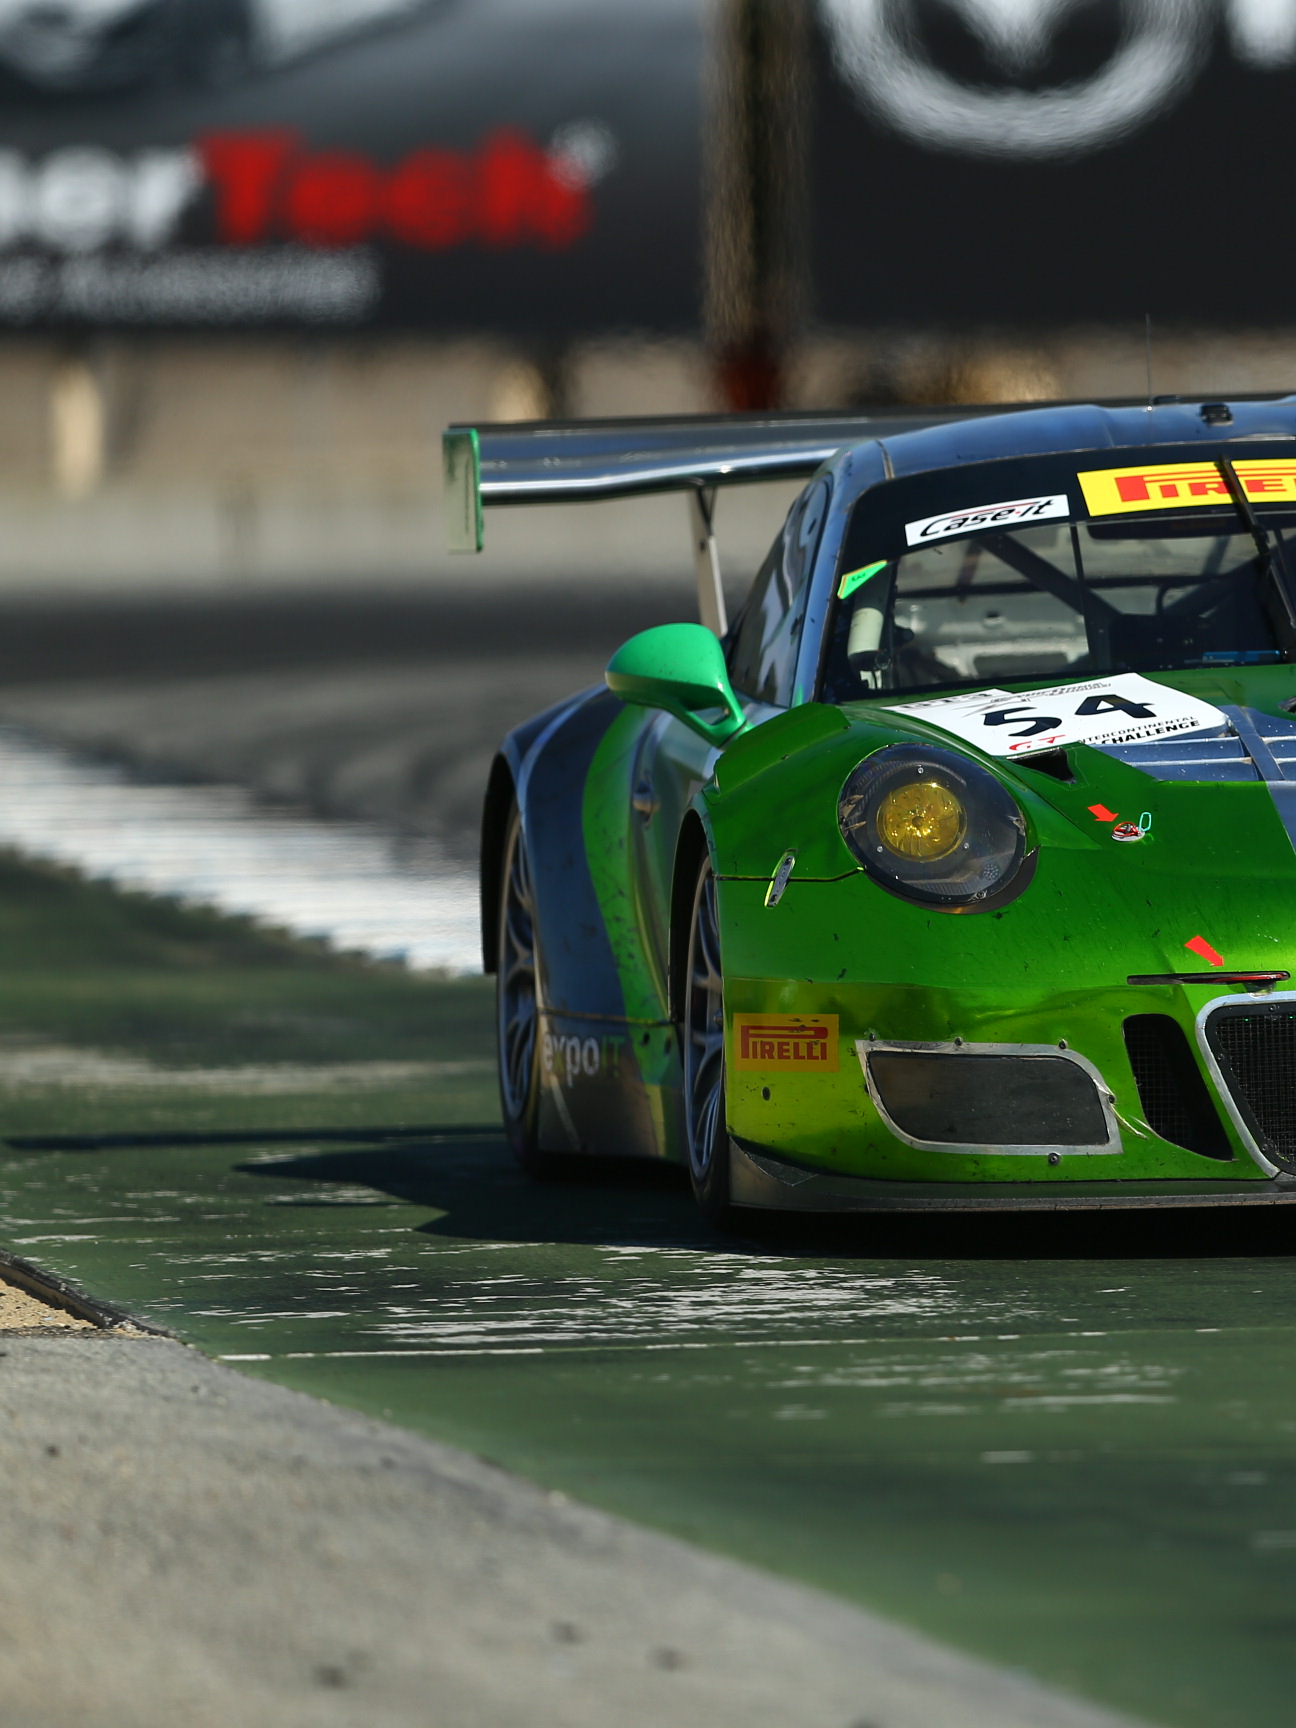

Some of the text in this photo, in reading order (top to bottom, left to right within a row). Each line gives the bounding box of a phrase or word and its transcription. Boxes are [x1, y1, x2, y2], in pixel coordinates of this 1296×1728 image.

[983, 694, 1158, 738] 54
[1102, 720, 1200, 744] CHALLENGE
[740, 1025, 829, 1061] PIRELLI
